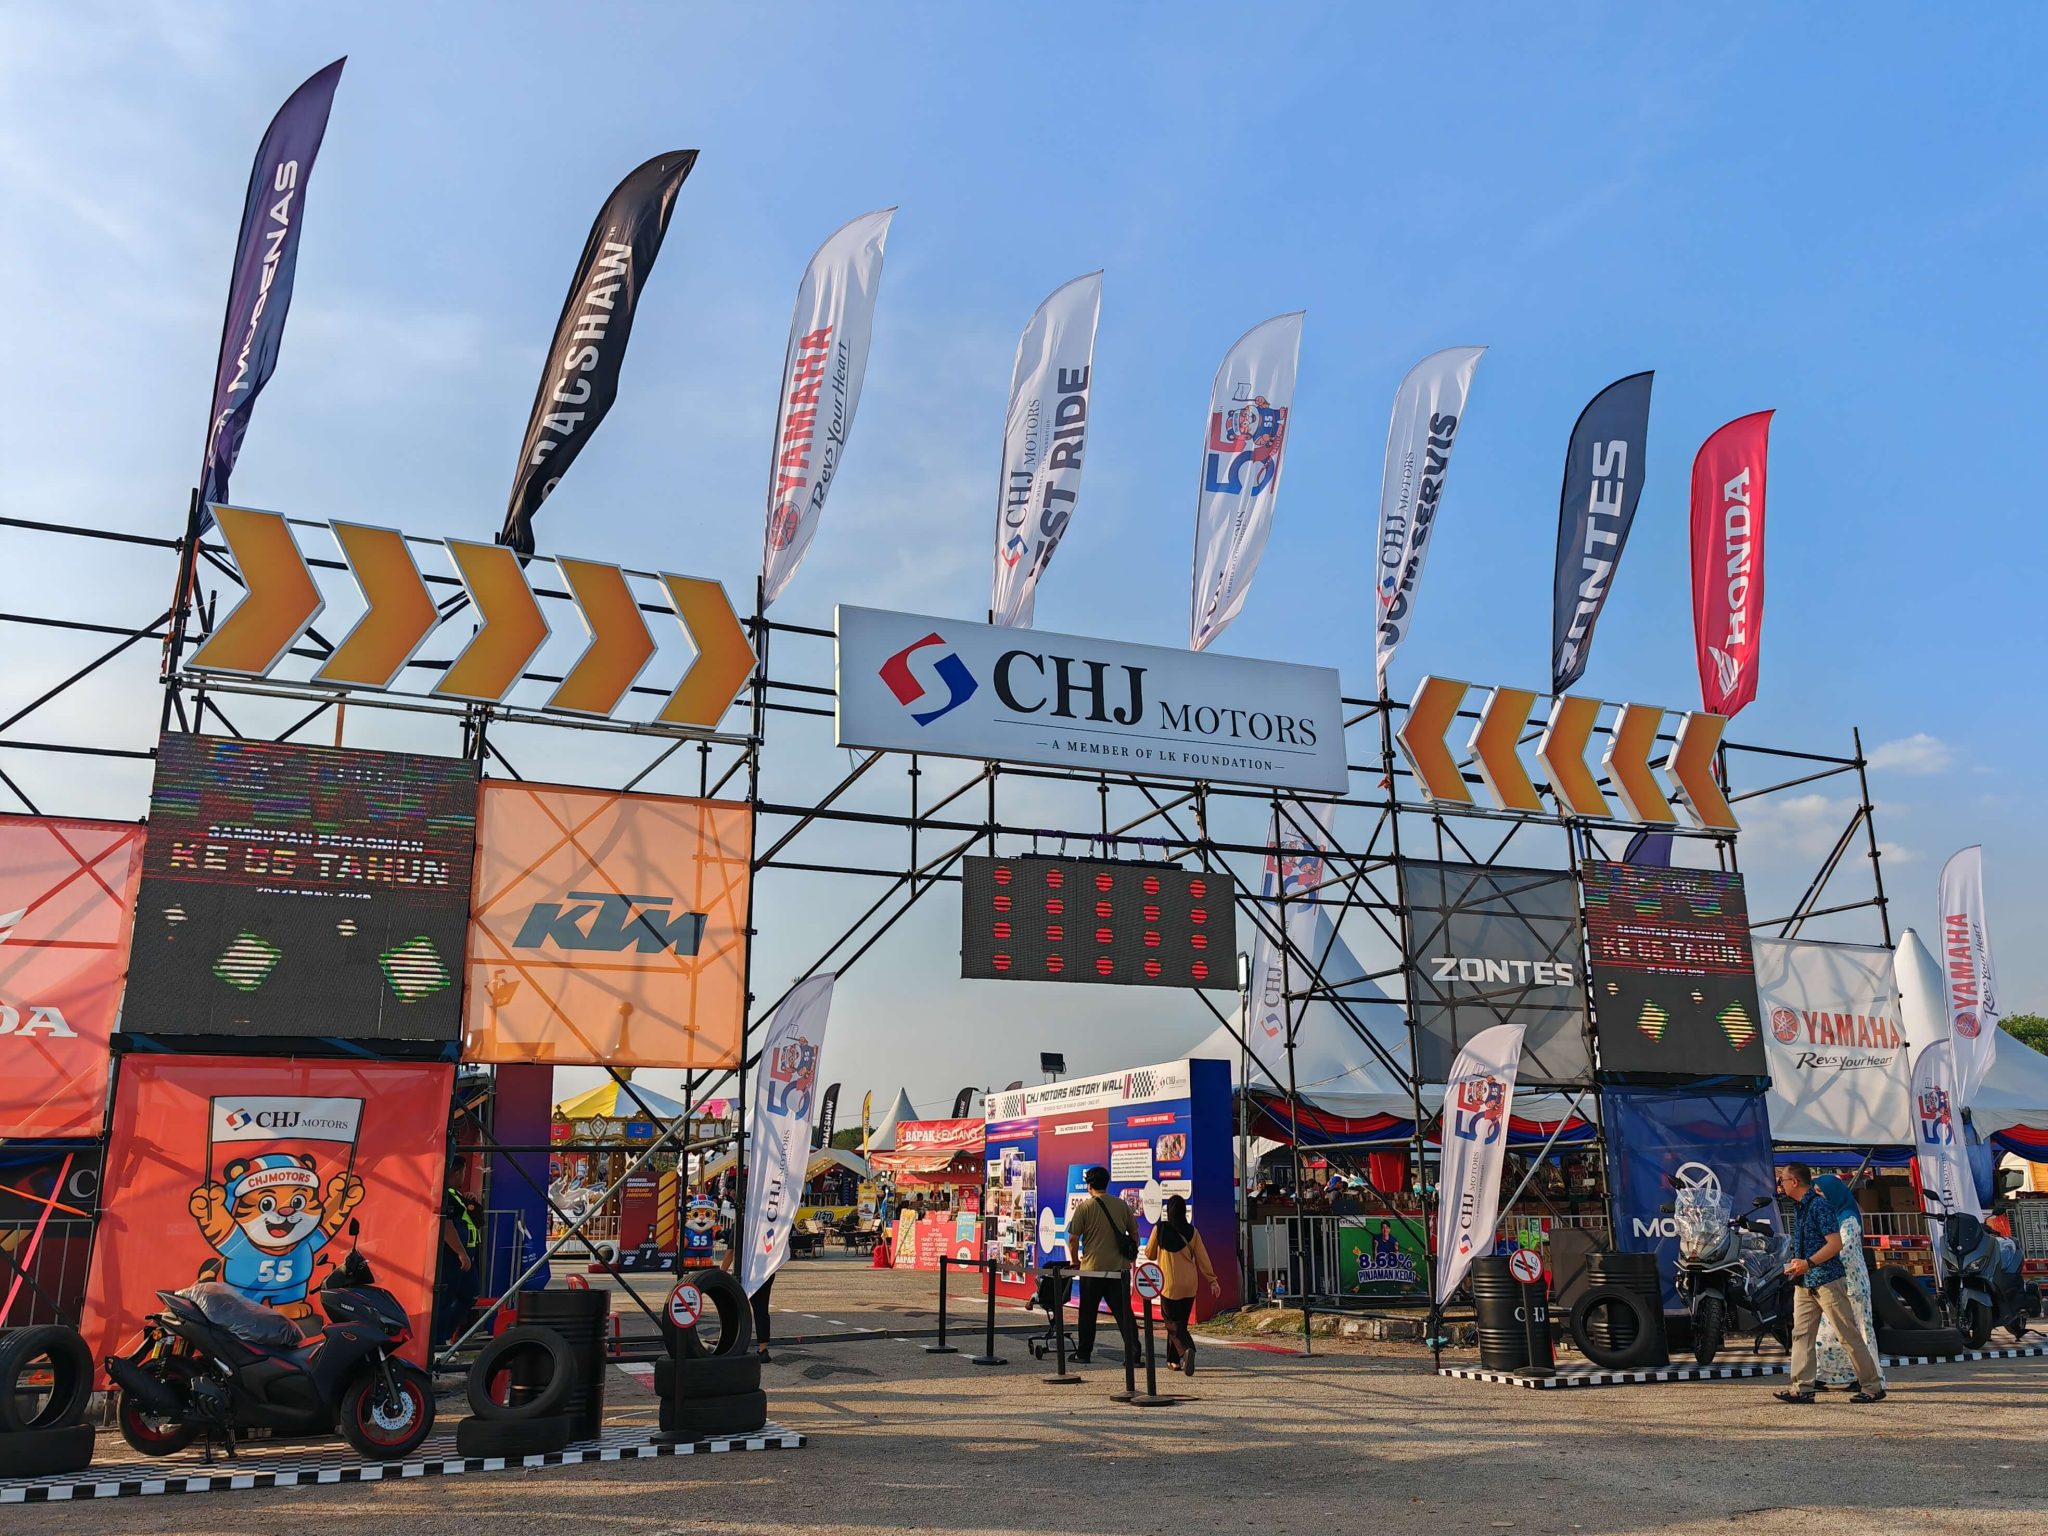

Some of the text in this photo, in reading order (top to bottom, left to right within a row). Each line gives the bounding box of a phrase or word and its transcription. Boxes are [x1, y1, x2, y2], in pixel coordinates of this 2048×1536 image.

[776, 325, 832, 498] YAMAHA
[809, 341, 848, 512] Revs Your Heart
[1049, 365, 1090, 470] RIDE
[1264, 415, 1273, 427] 55
[1005, 399, 1040, 528] CHJ MOTORS
[1412, 412, 1457, 551] SERVIS
[1382, 451, 1415, 568] CHJ MOTORS
[1723, 466, 1750, 648] HONDA
[993, 650, 1317, 747] CHJ MOTORS
[1052, 739, 1273, 771] A MEMBER OF LK FOUNDATION
[170, 842, 229, 870] KE
[313, 853, 450, 885] TAHUN
[512, 891, 708, 956] KTM
[1431, 957, 1575, 988] ZONTES
[1946, 913, 1979, 1009] YAMAHA
[1976, 921, 1999, 1018] Revs Your Heart
[1265, 967, 1282, 1008] CHJ
[1802, 1010, 1901, 1049] YAMAHA
[1796, 1052, 1893, 1070] Revs Your Heart
[1026, 1079, 1123, 1104] CHJ MOTORS HISTORY WALL
[255, 1111, 348, 1130] CHJ MOTORS
[905, 1129, 935, 1142] BAPAK
[247, 1171, 311, 1188] CHJMOTORS
[767, 1179, 782, 1223] CHJ
[778, 1130, 790, 1176] MOTORS
[1461, 1151, 1479, 1229] CHJ MOTORS
[1943, 1189, 1955, 1214] HJ
[645, 1250, 652, 1259] 1
[693, 1236, 708, 1246] 55
[258, 1260, 293, 1283] 55
[624, 1256, 636, 1265] 2
[660, 1259, 673, 1268] 3
[1358, 1269, 1416, 1283] PINJAMAN KEDAI
[1359, 1252, 1413, 1270] 8.68%
